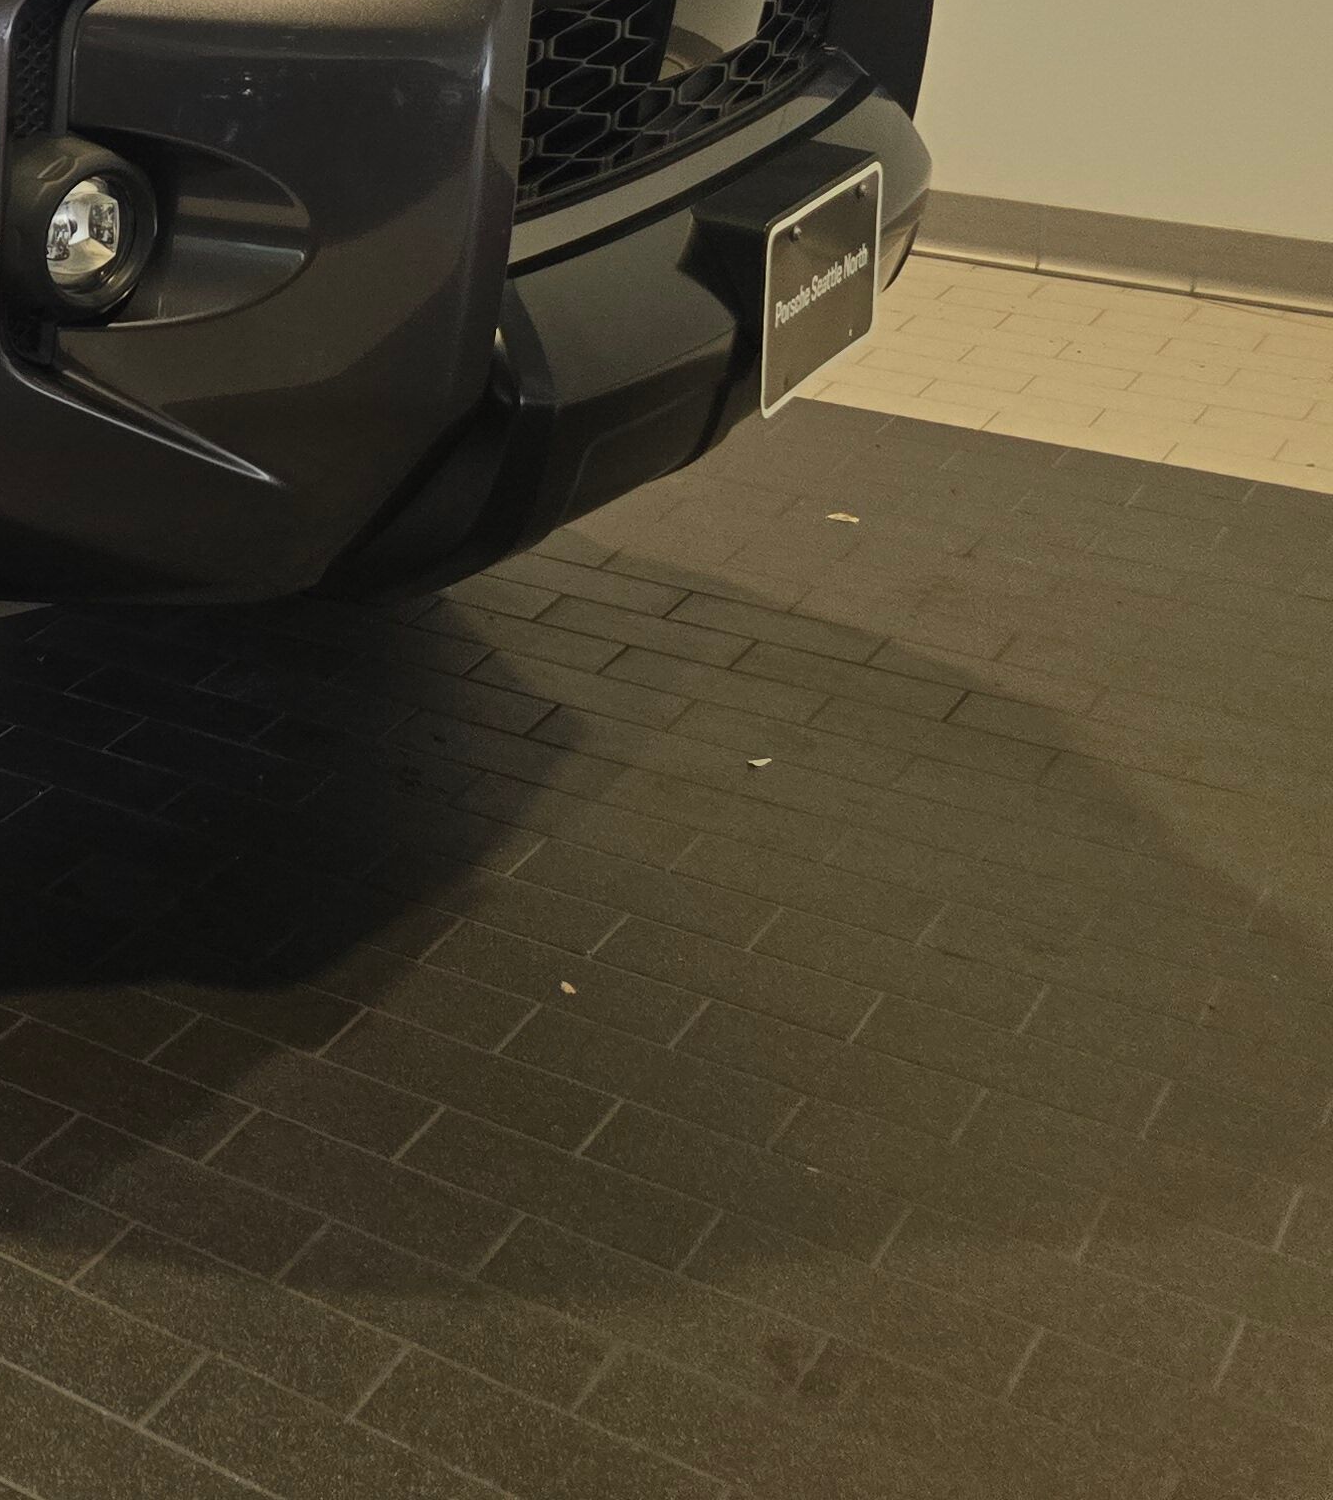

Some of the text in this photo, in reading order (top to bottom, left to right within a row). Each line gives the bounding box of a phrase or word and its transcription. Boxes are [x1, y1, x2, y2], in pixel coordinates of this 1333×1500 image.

[774, 243, 869, 329] Porsche Seattle North
